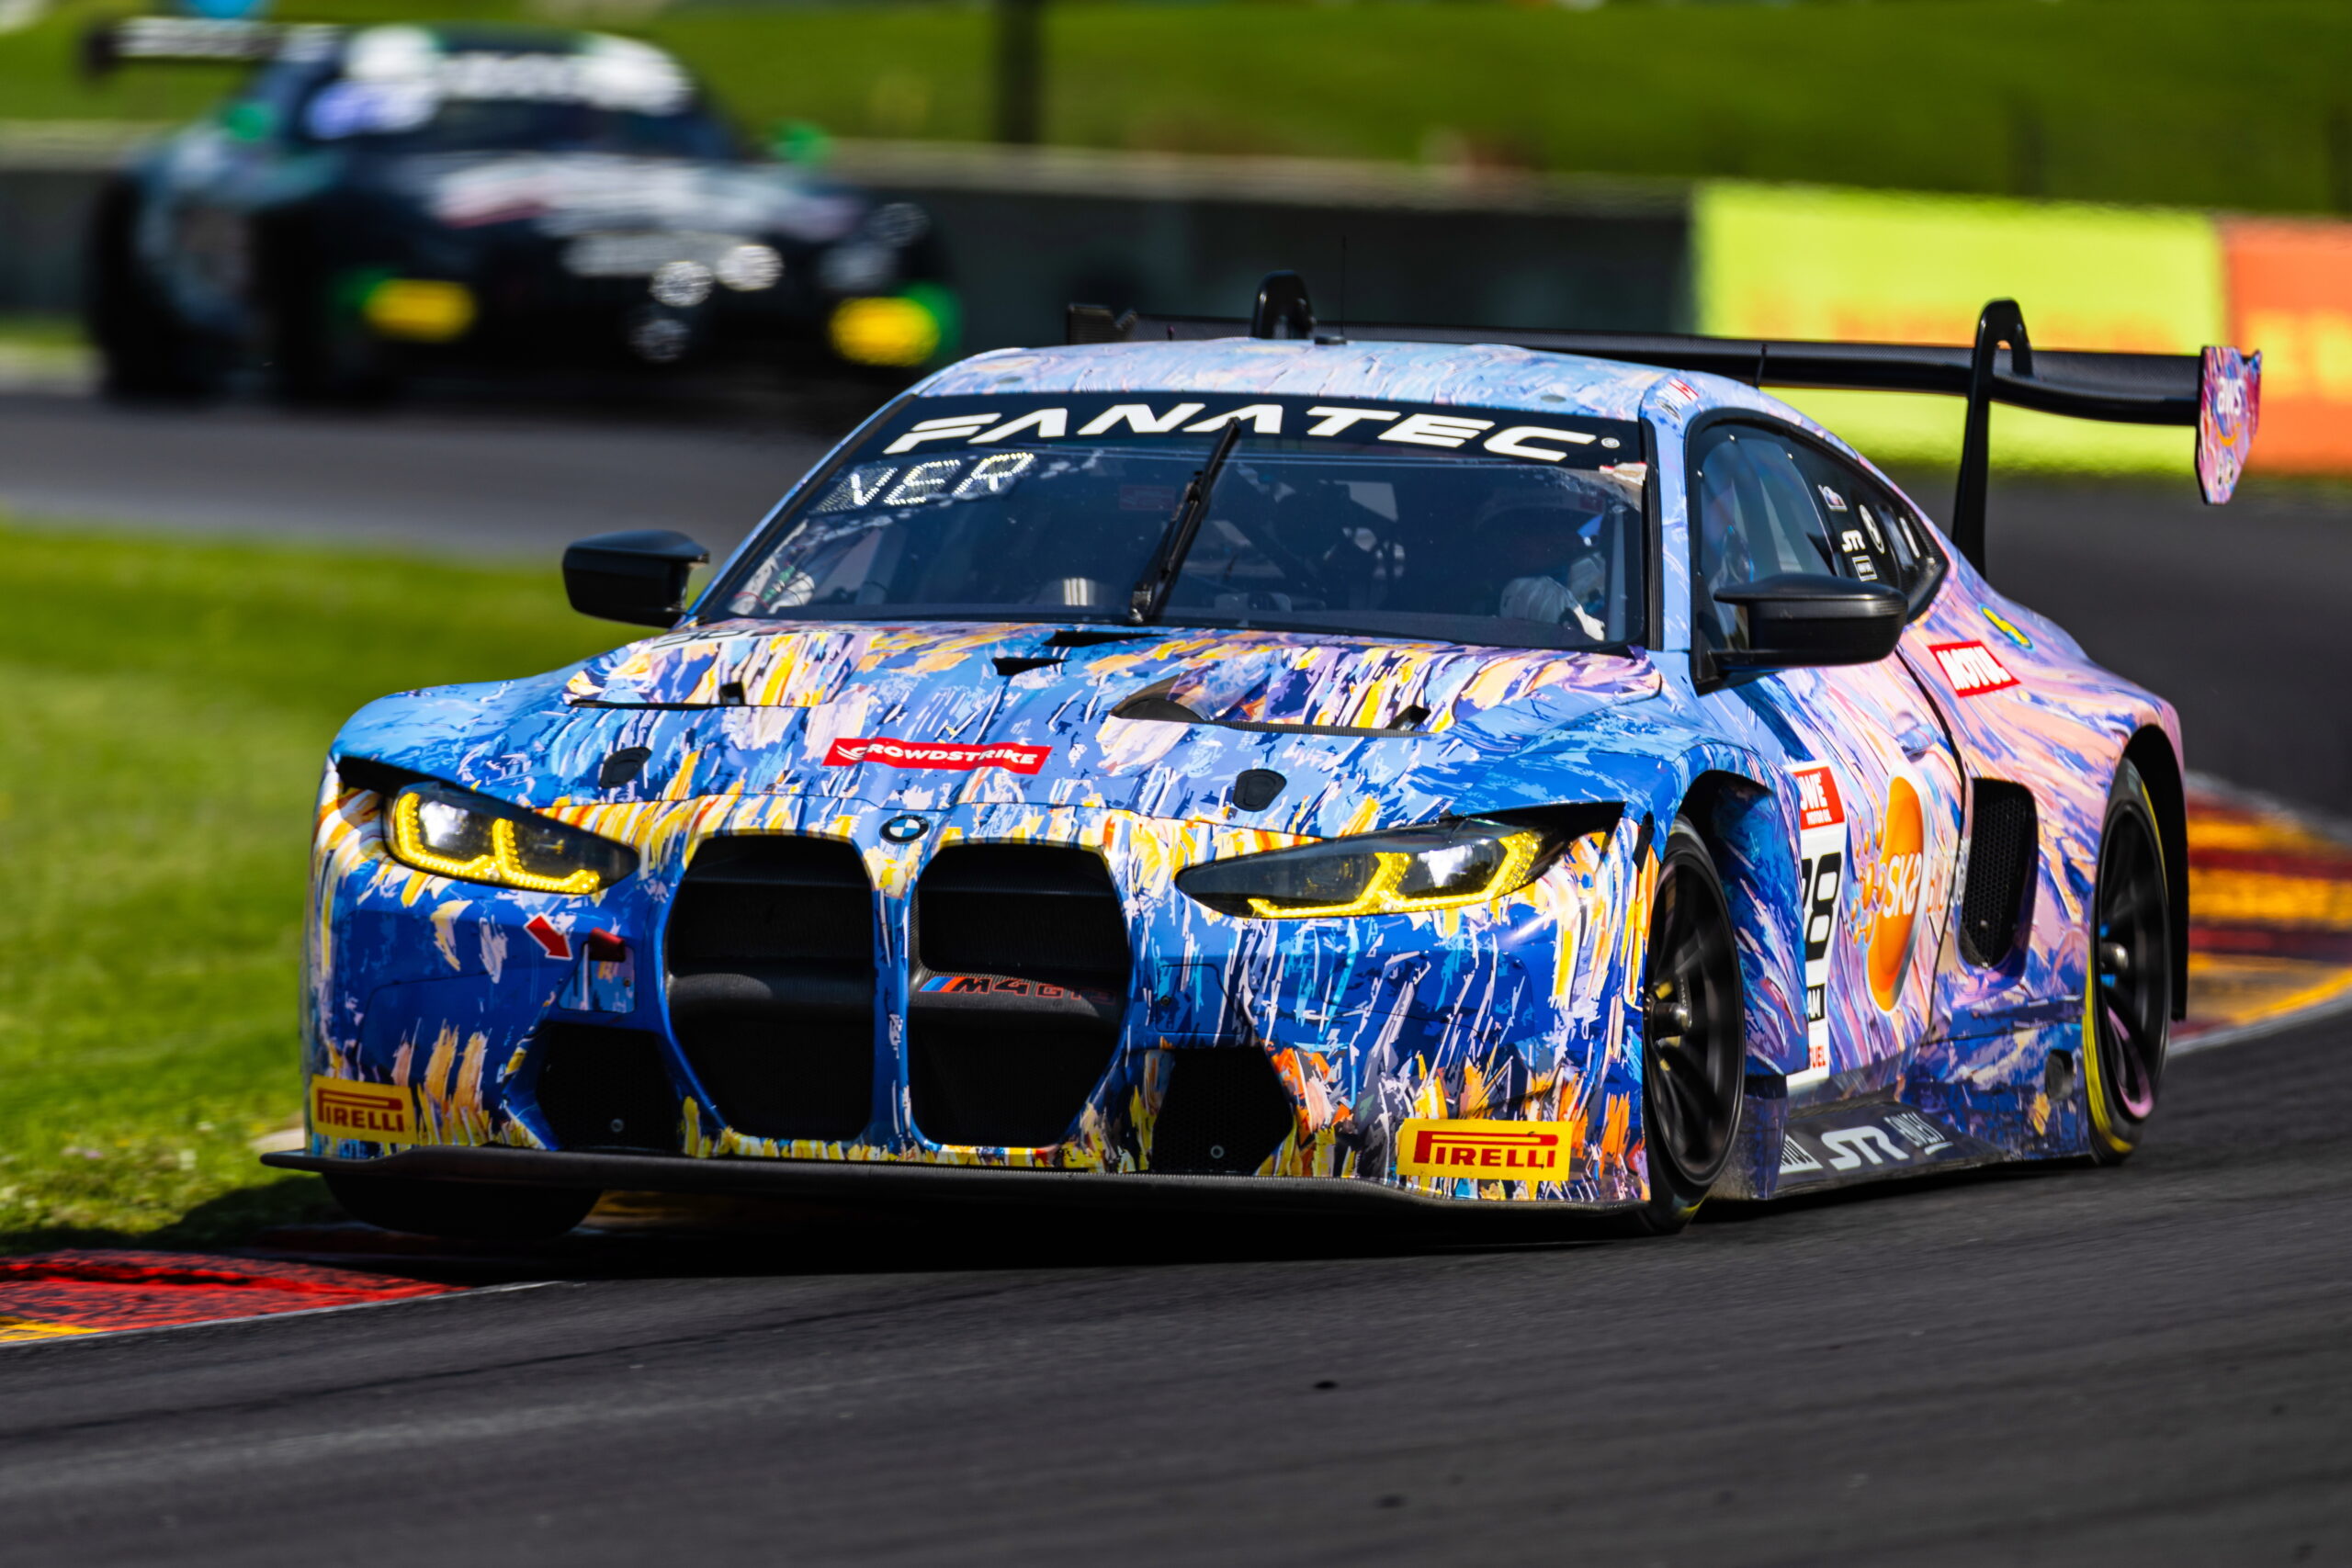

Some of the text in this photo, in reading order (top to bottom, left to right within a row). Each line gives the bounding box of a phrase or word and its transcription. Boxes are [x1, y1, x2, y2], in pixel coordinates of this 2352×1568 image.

[883, 402, 1598, 463] FANATEC
[1935, 645, 2013, 691] MOTUL
[838, 744, 1038, 766] CROWDSTRIKE
[1798, 773, 1828, 810] OWE
[316, 1087, 405, 1133] PIRELLI
[1413, 1130, 1559, 1168] PIRELLI
